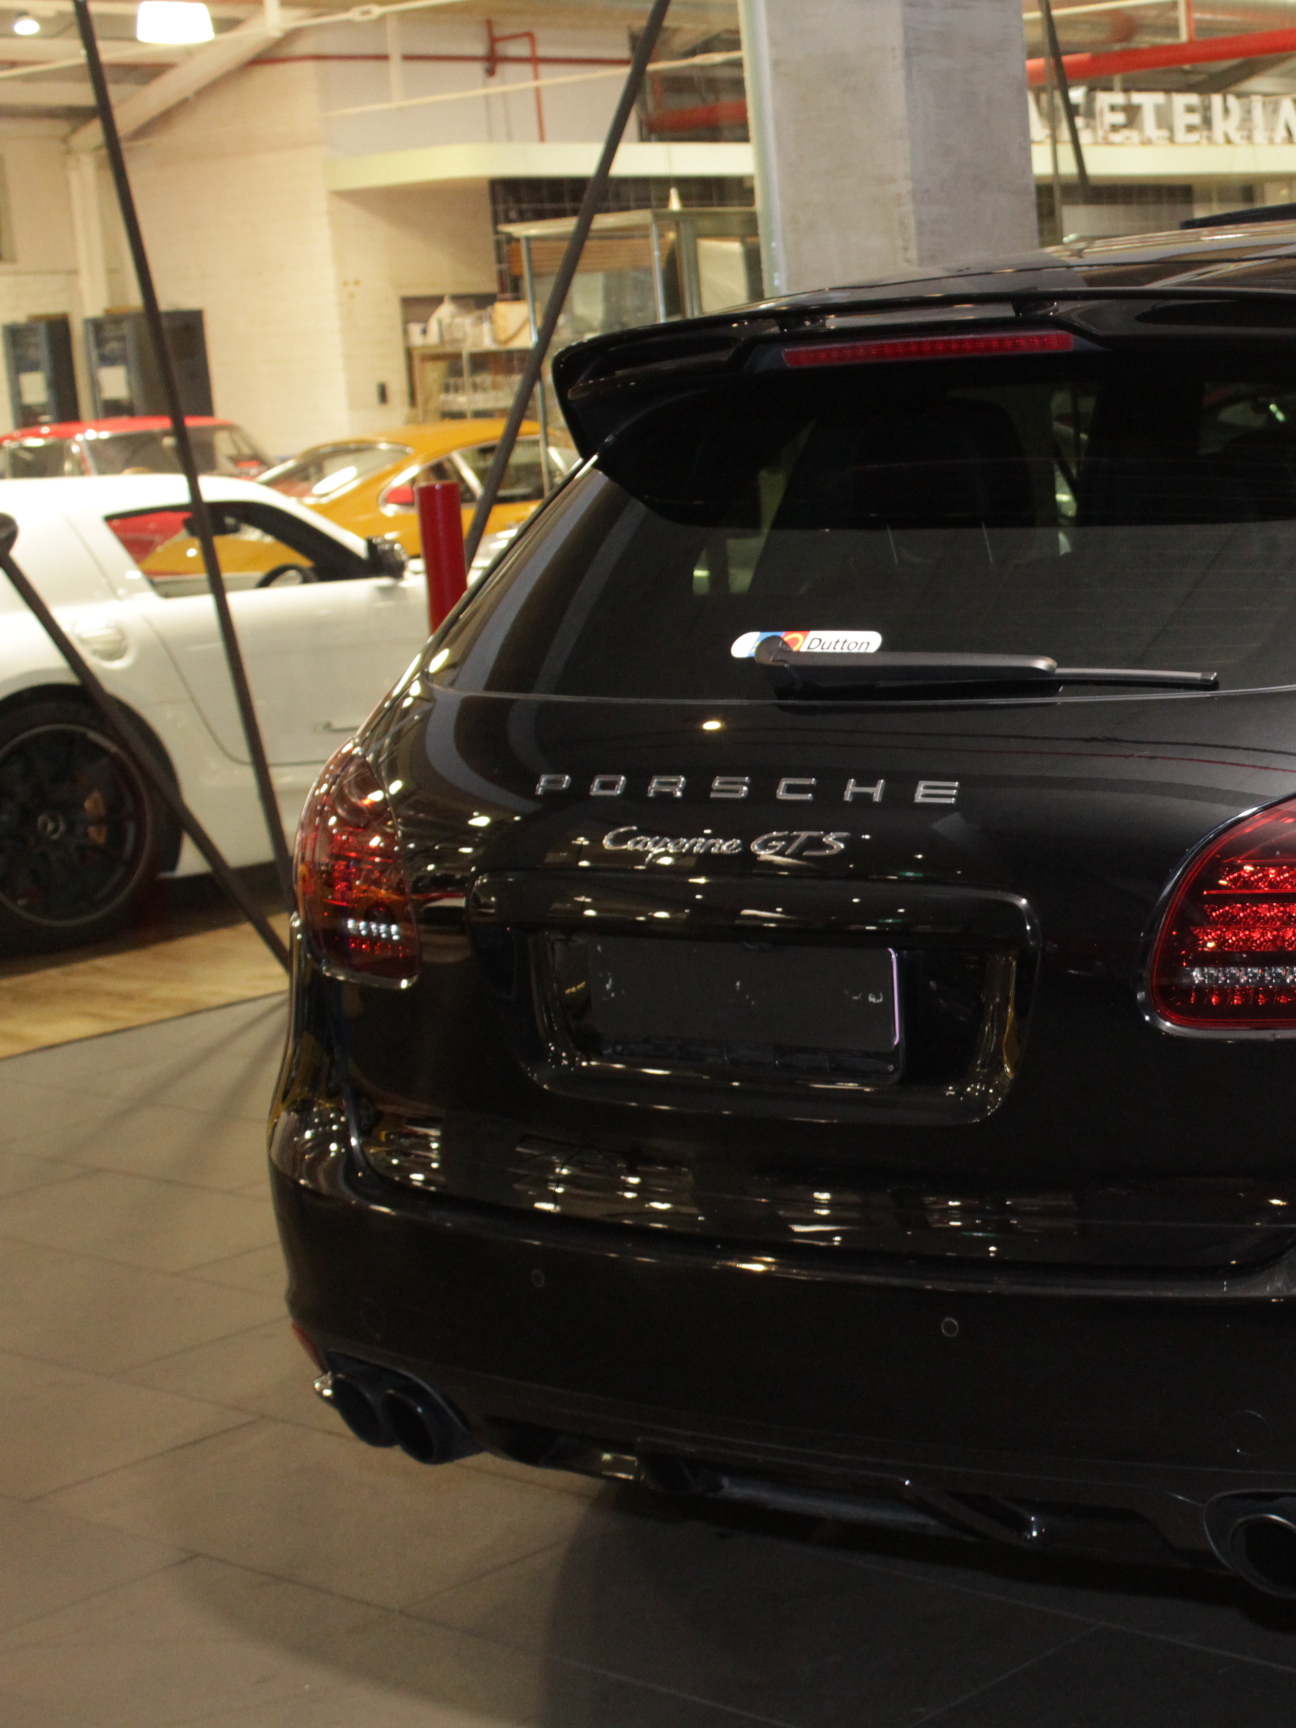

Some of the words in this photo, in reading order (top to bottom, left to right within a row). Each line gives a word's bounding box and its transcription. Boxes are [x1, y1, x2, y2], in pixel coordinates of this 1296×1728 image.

[807, 637, 871, 651] Dutton
[535, 773, 960, 804] PORSCHE
[603, 826, 742, 867] Cayenne
[751, 831, 850, 856] GTS
